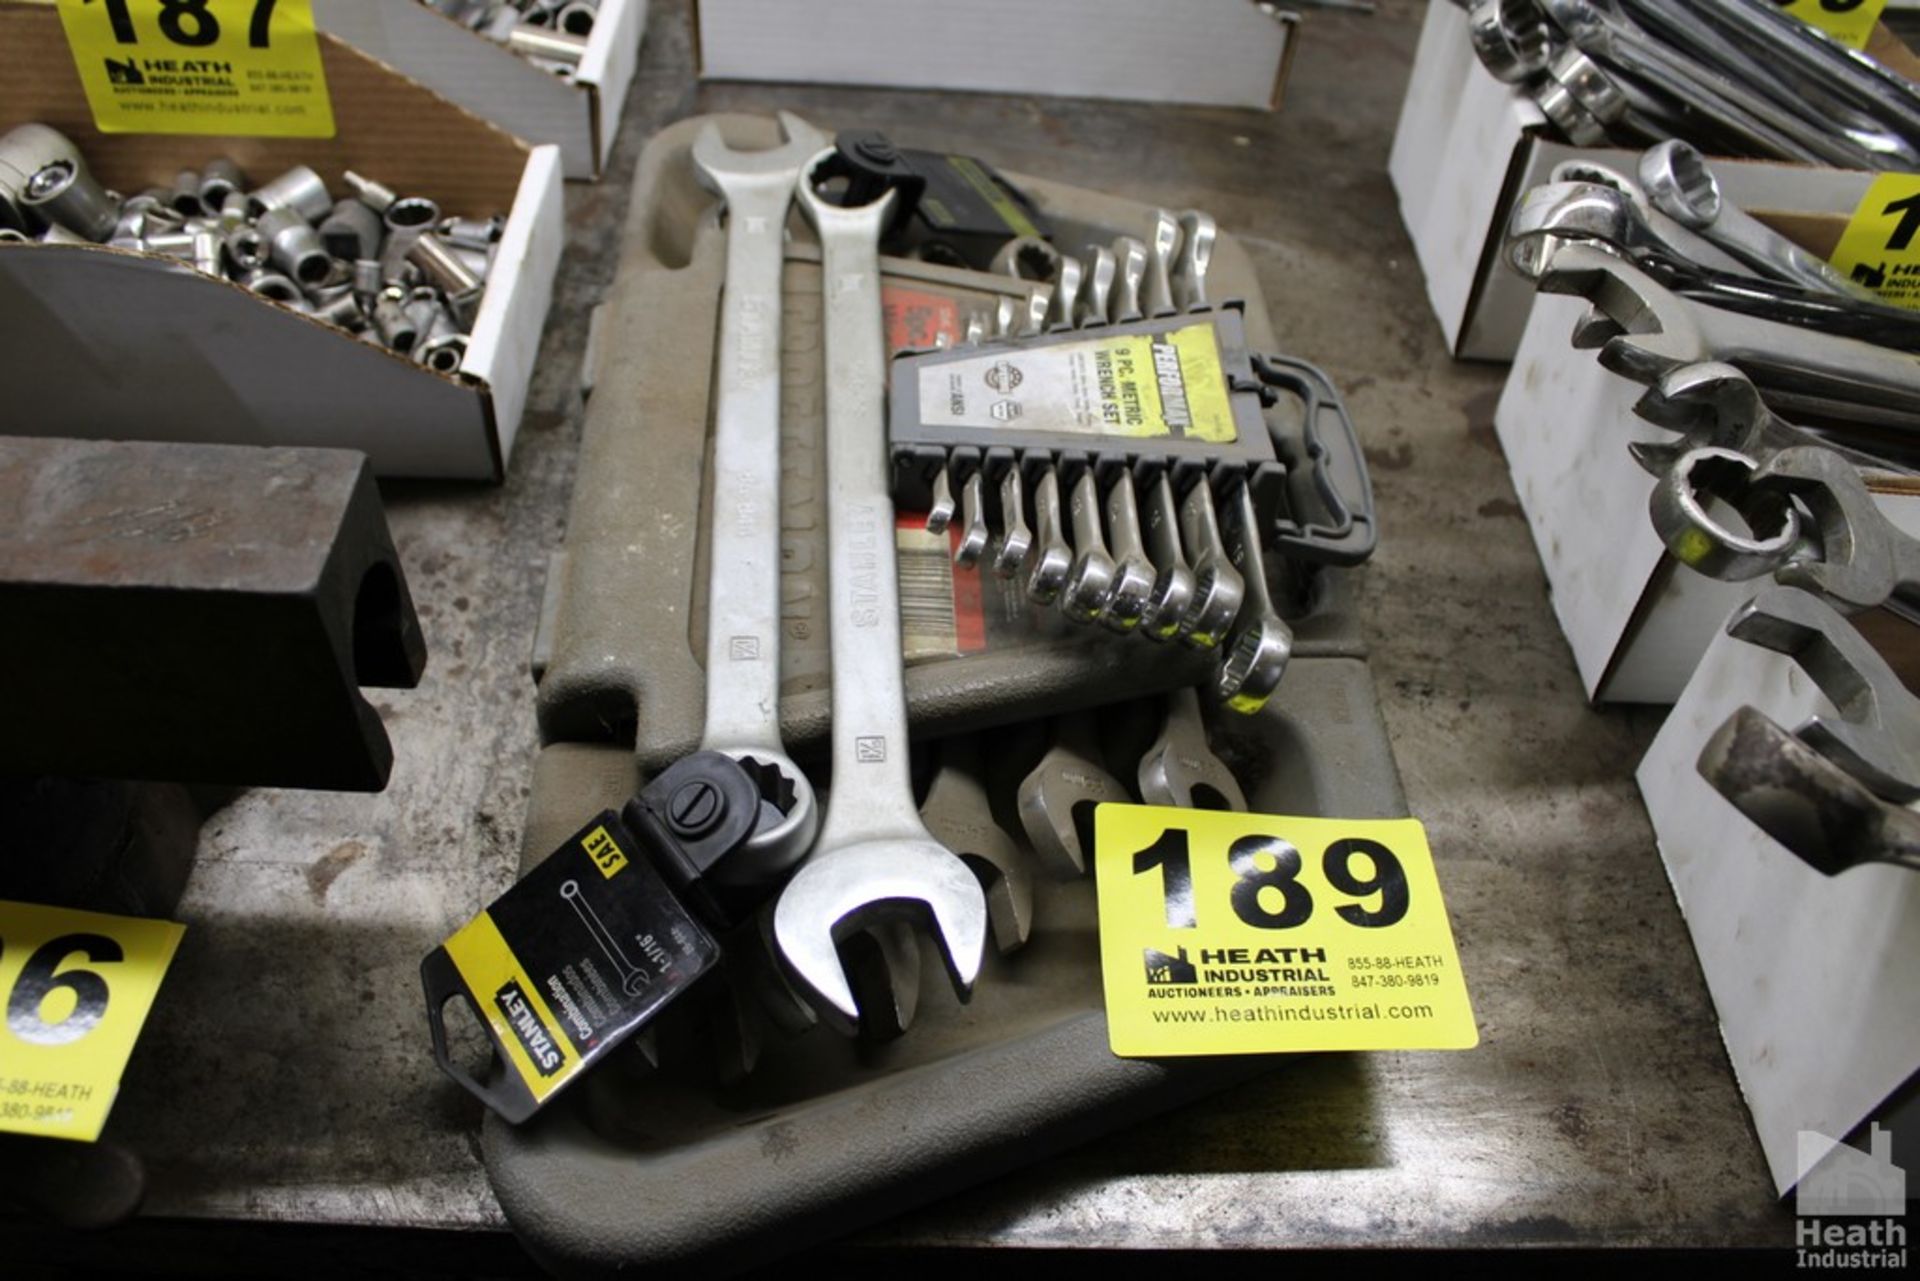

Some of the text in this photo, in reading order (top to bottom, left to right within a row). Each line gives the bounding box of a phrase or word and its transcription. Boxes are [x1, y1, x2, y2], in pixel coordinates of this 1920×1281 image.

[142, 59, 232, 73] HEATH
[149, 75, 234, 87] INDUSTRIAL
[1115, 348, 1130, 357] 9
[1095, 349, 1120, 425] WRENCH SET
[1121, 381, 1143, 425] METRIC
[589, 833, 620, 869] SAE
[1132, 828, 1410, 930] 189
[1201, 947, 1327, 964] HEATH
[1348, 955, 1444, 970] 855-88-HEATH
[1205, 968, 1329, 982] INDUSTRIAL
[1352, 973, 1439, 988] 847-380-9819
[1148, 985, 1335, 999] AUCTIONEERS APPRAISERS
[546, 974, 593, 1040] Combination
[1152, 1003, 1433, 1024] www.heathindustrial.com
[500, 990, 560, 1069] STANLEY
